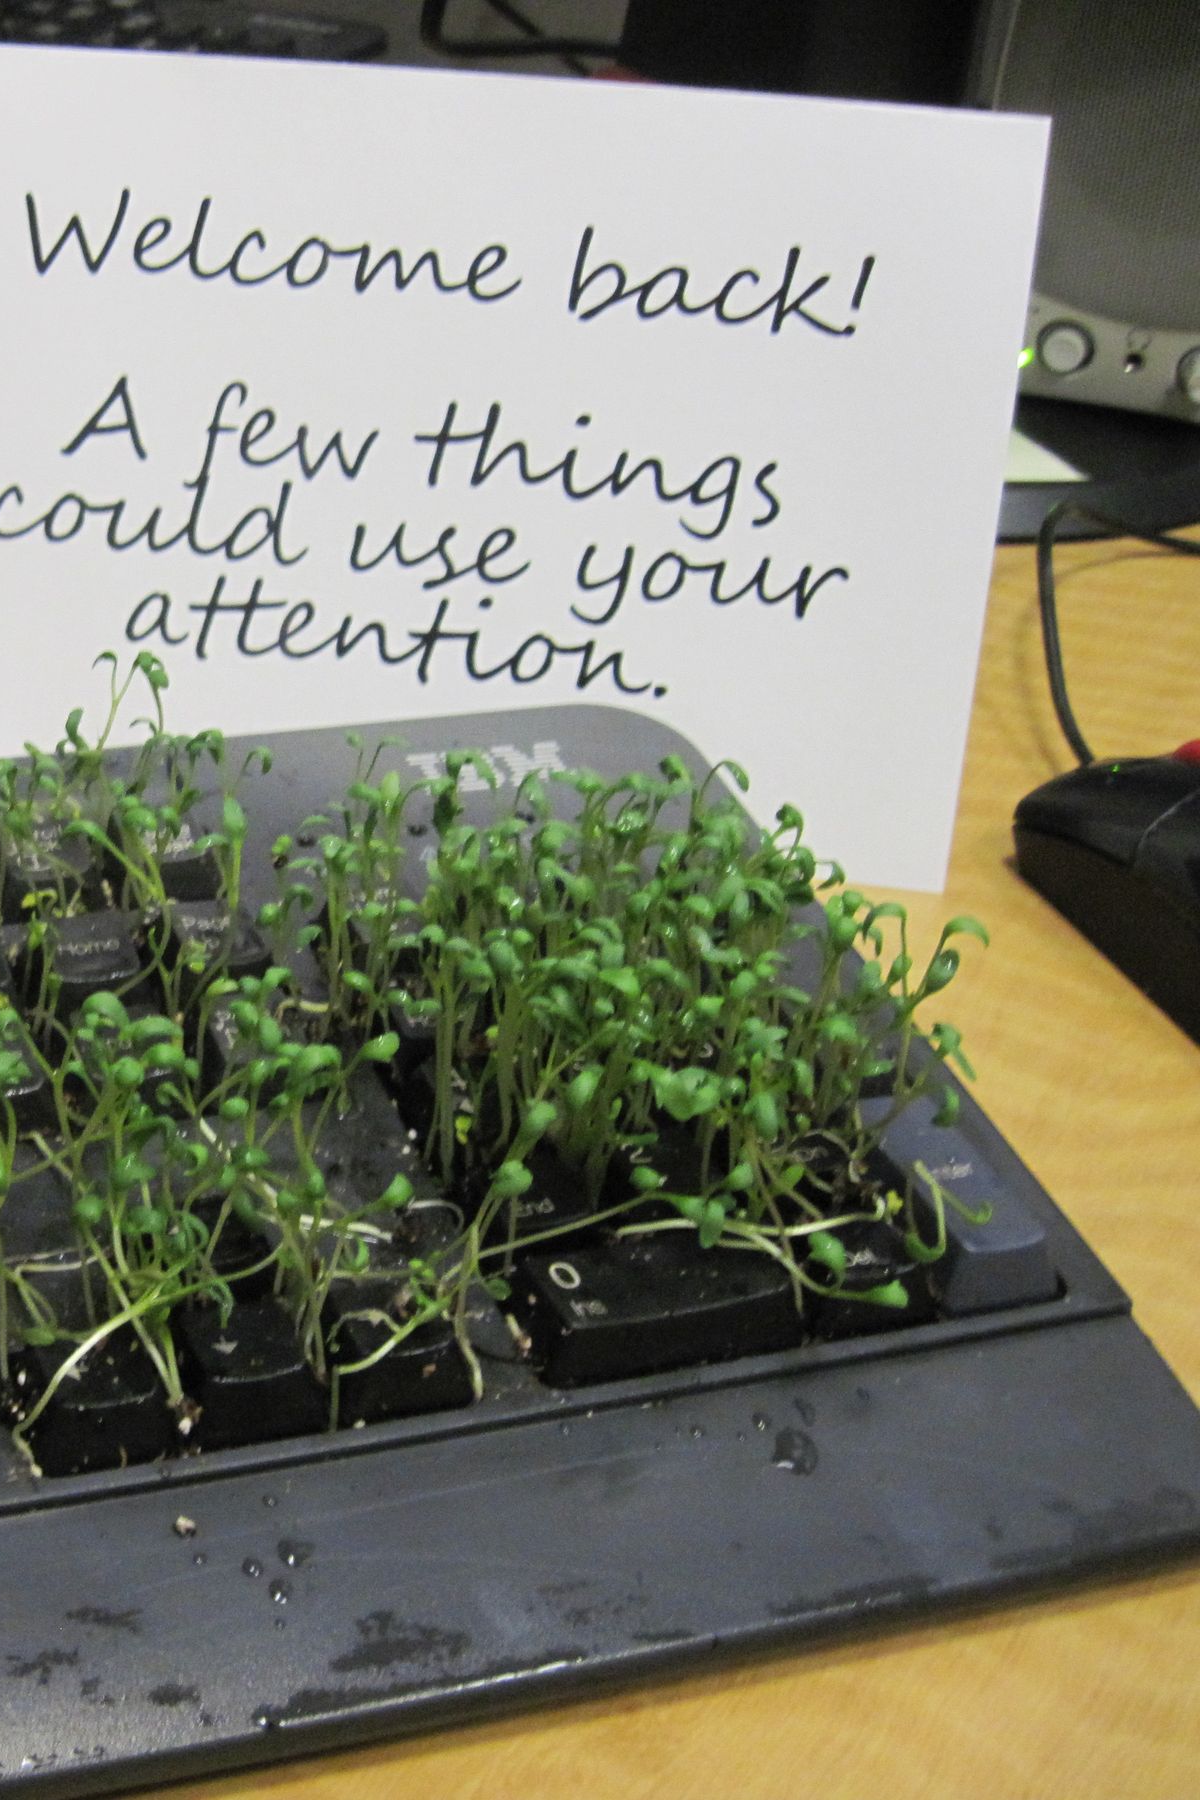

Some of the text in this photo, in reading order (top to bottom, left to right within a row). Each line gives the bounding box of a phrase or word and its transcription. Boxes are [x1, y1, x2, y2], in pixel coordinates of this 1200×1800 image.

[25, 186, 877, 338] Welcome back!
[60, 375, 782, 541] A few things
[123, 573, 669, 700] attention.
[349, 521, 531, 590] use
[570, 539, 850, 626] your
